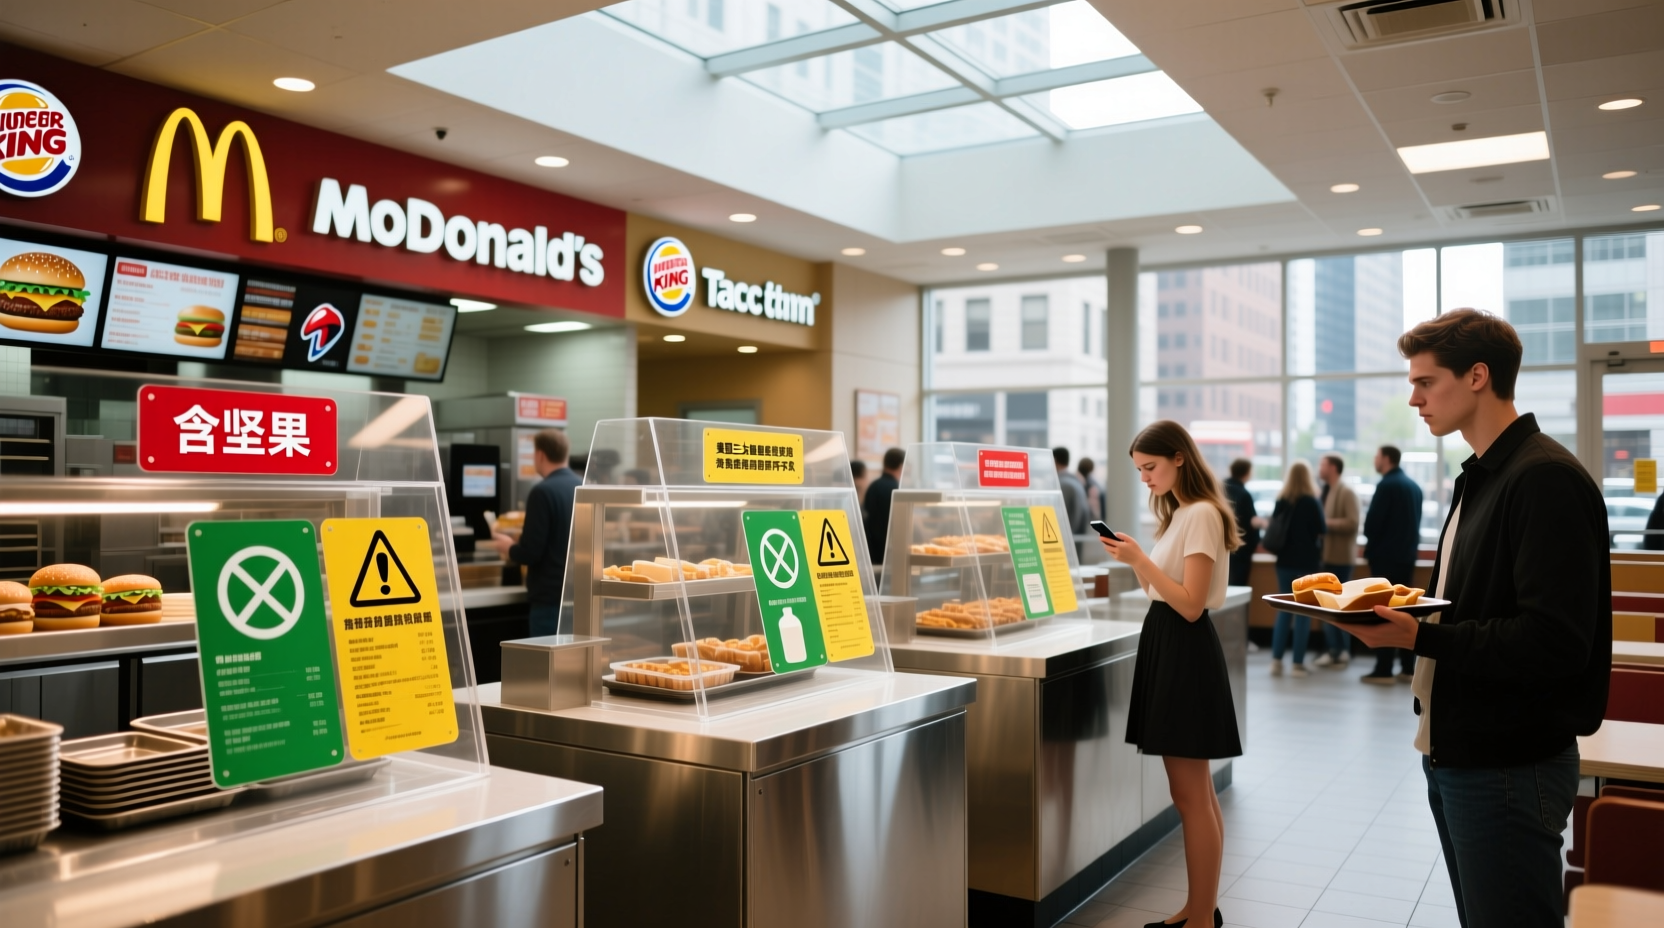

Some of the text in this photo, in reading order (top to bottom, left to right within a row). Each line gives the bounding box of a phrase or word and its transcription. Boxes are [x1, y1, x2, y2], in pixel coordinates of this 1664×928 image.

[0, 128, 67, 160] ING
[313, 177, 605, 287] MoDonald's
[173, 404, 311, 458] 含坚果
